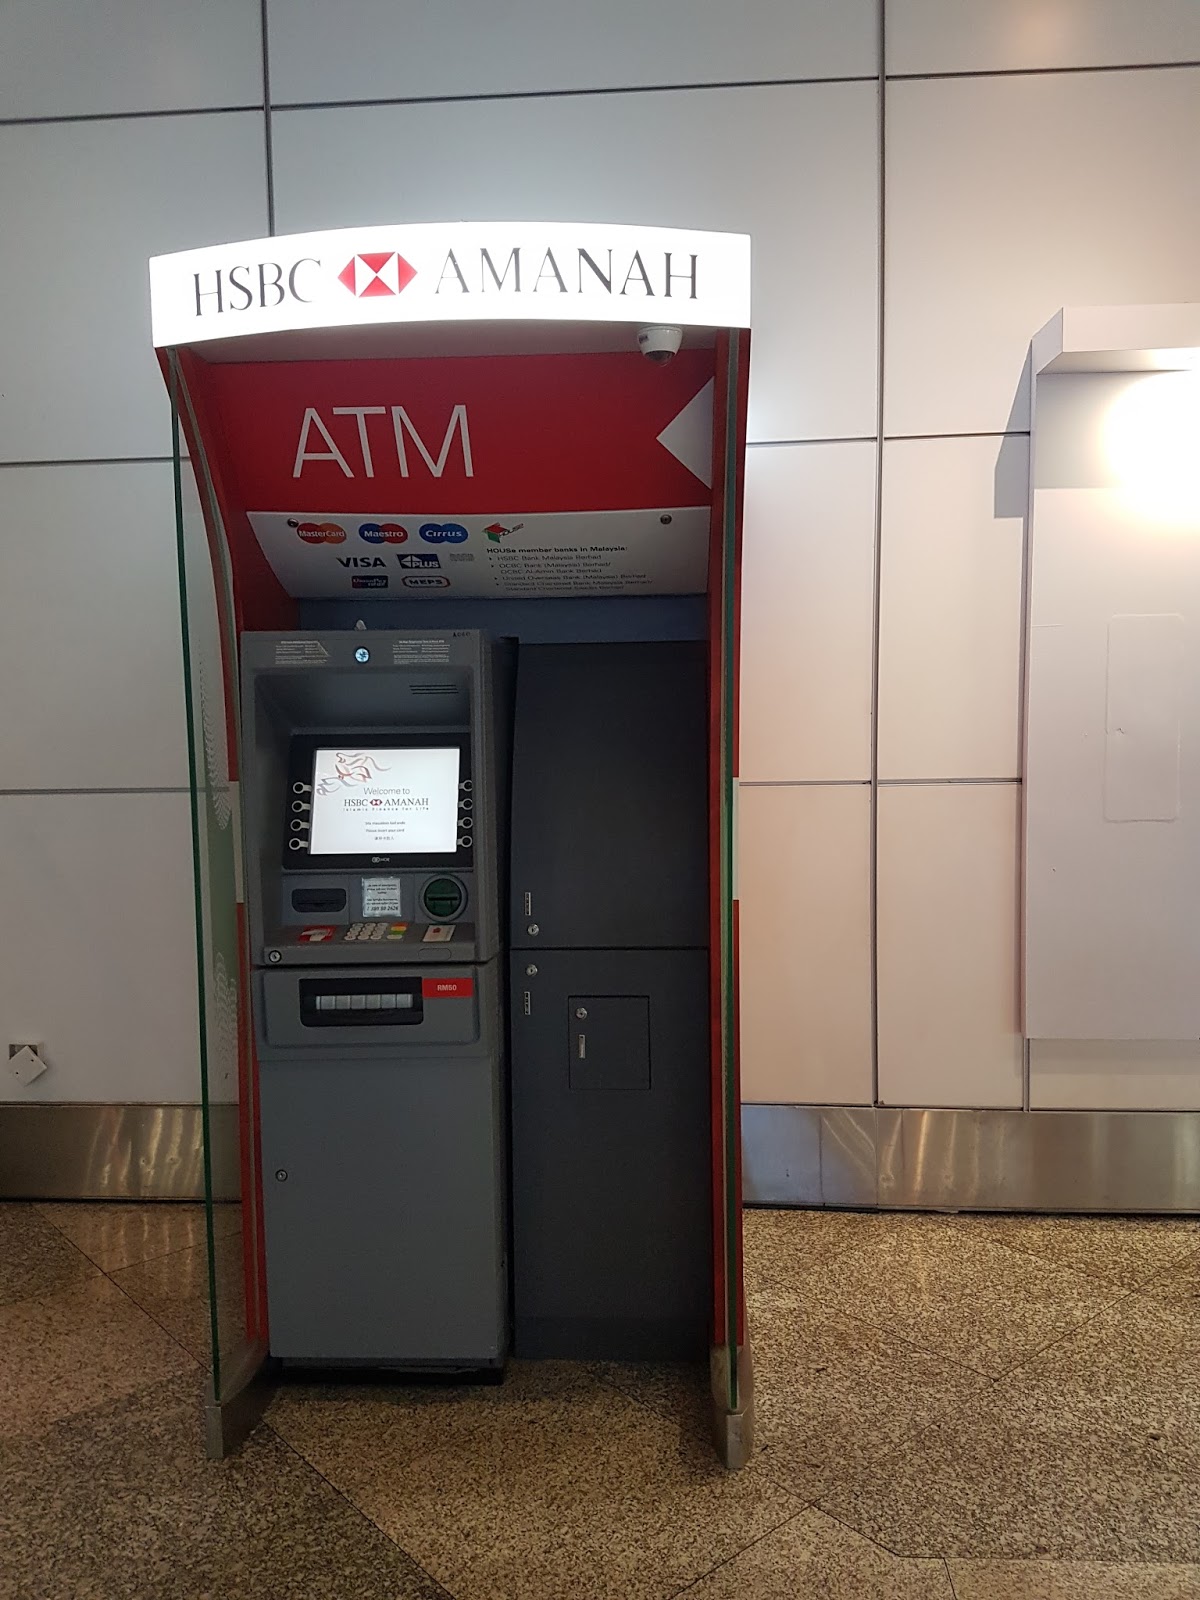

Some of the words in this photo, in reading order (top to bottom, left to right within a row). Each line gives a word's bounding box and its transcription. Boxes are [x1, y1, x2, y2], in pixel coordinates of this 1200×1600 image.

[192, 258, 322, 316] HSBC
[435, 247, 699, 299] AMANAH
[292, 405, 475, 478] ATM
[299, 530, 345, 538] MasterCard
[364, 530, 404, 538] Maestro
[425, 530, 462, 538] Cirrus
[336, 557, 386, 568] VISA
[363, 787, 401, 795] Welcome
[344, 799, 369, 807] HSBC
[384, 797, 429, 806] AMANAH
